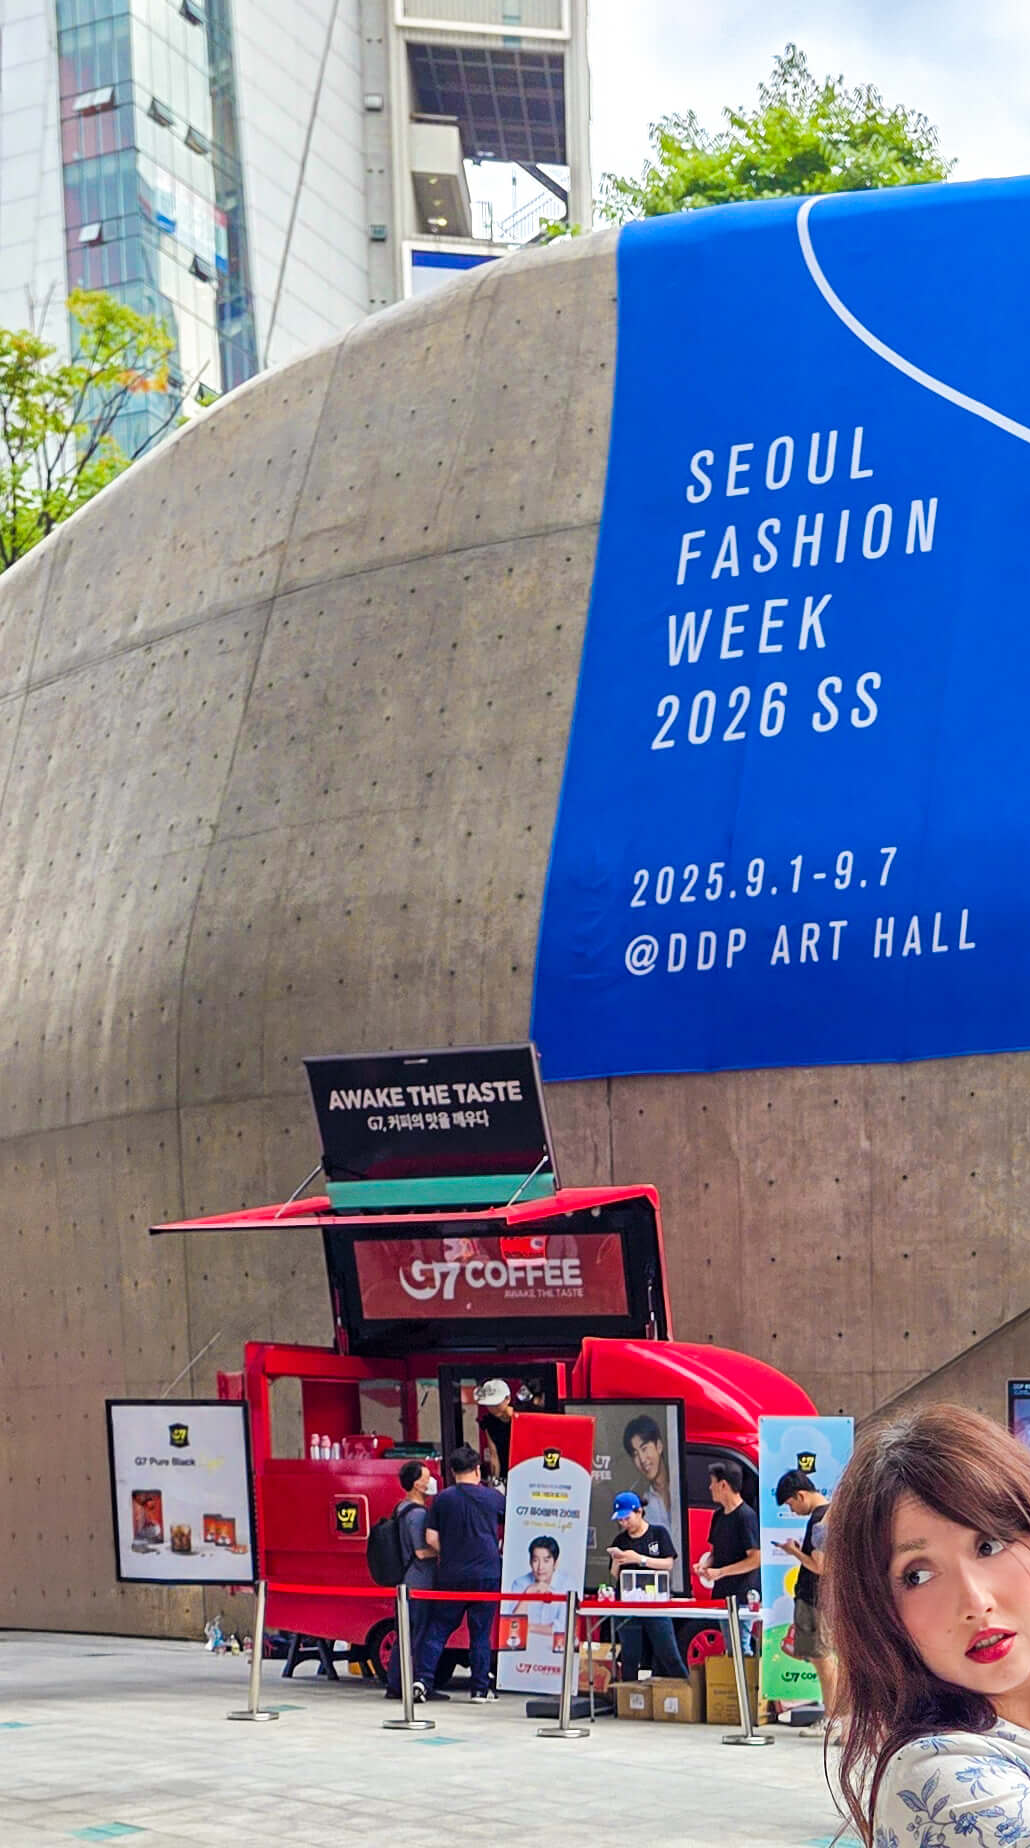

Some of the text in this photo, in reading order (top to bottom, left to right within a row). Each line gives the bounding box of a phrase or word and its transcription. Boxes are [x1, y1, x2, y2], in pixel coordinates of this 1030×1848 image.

[686, 426, 873, 504] SEOUL
[676, 497, 938, 585] FASHION
[668, 593, 833, 667] WEEK
[651, 671, 881, 750] 2026 SS
[630, 846, 897, 907] 2025.9.1-9.7
[624, 908, 975, 976] @DDP ART HALL
[329, 1080, 523, 1110] AWAKE THE TASTE
[367, 1116, 388, 1132] G7,
[388, 1112, 424, 1131] 커피의
[425, 1111, 450, 1130] 맛을
[400, 1258, 583, 1300] G7 COFFEE
[337, 1508, 357, 1522] G7
